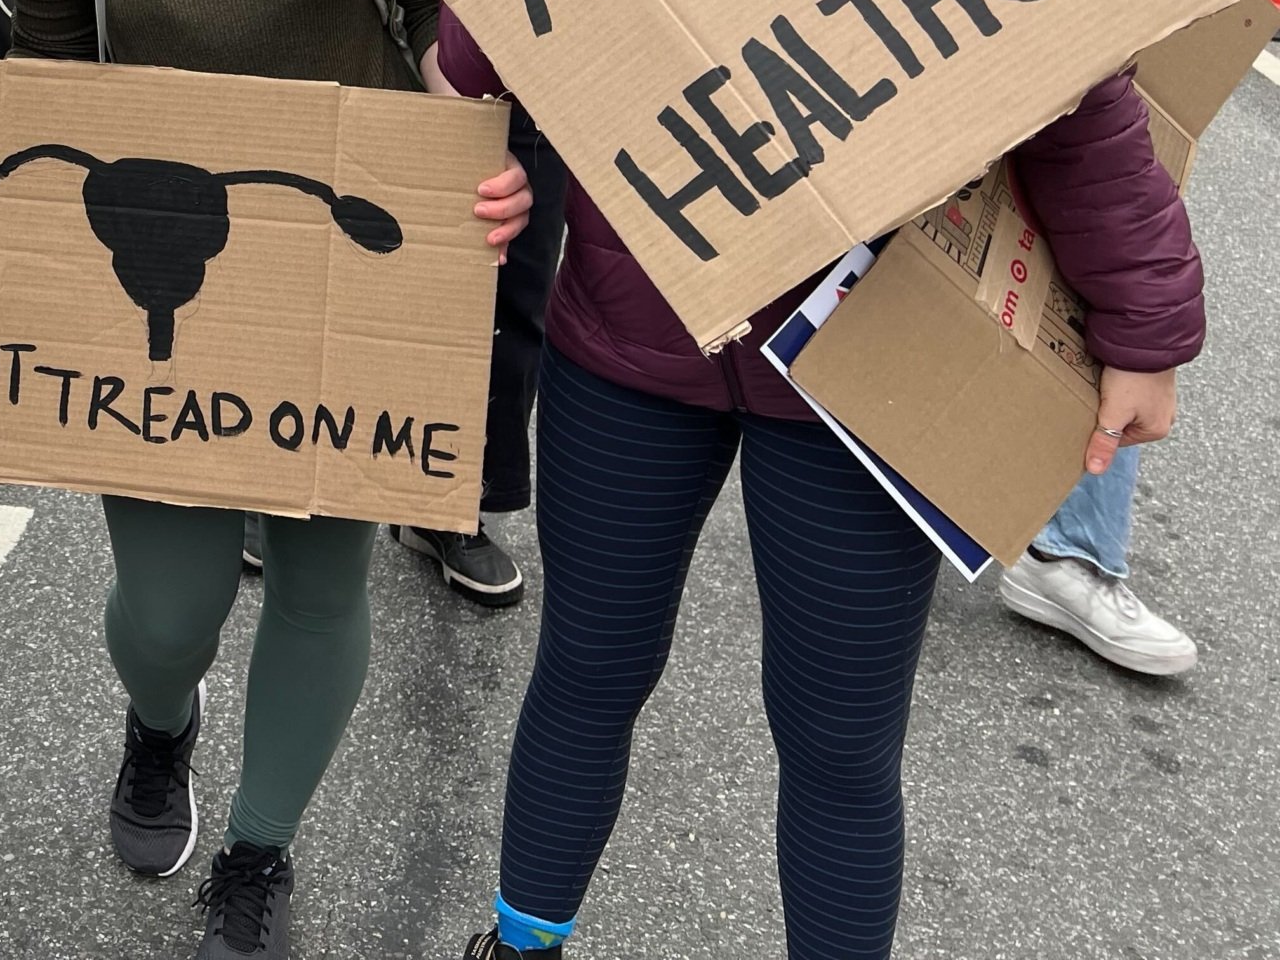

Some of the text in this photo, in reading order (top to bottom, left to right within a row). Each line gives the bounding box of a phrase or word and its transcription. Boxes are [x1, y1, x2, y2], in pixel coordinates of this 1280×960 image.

[34, 366, 252, 444] TREAD
[269, 401, 356, 452] ON
[373, 410, 461, 478] ME
